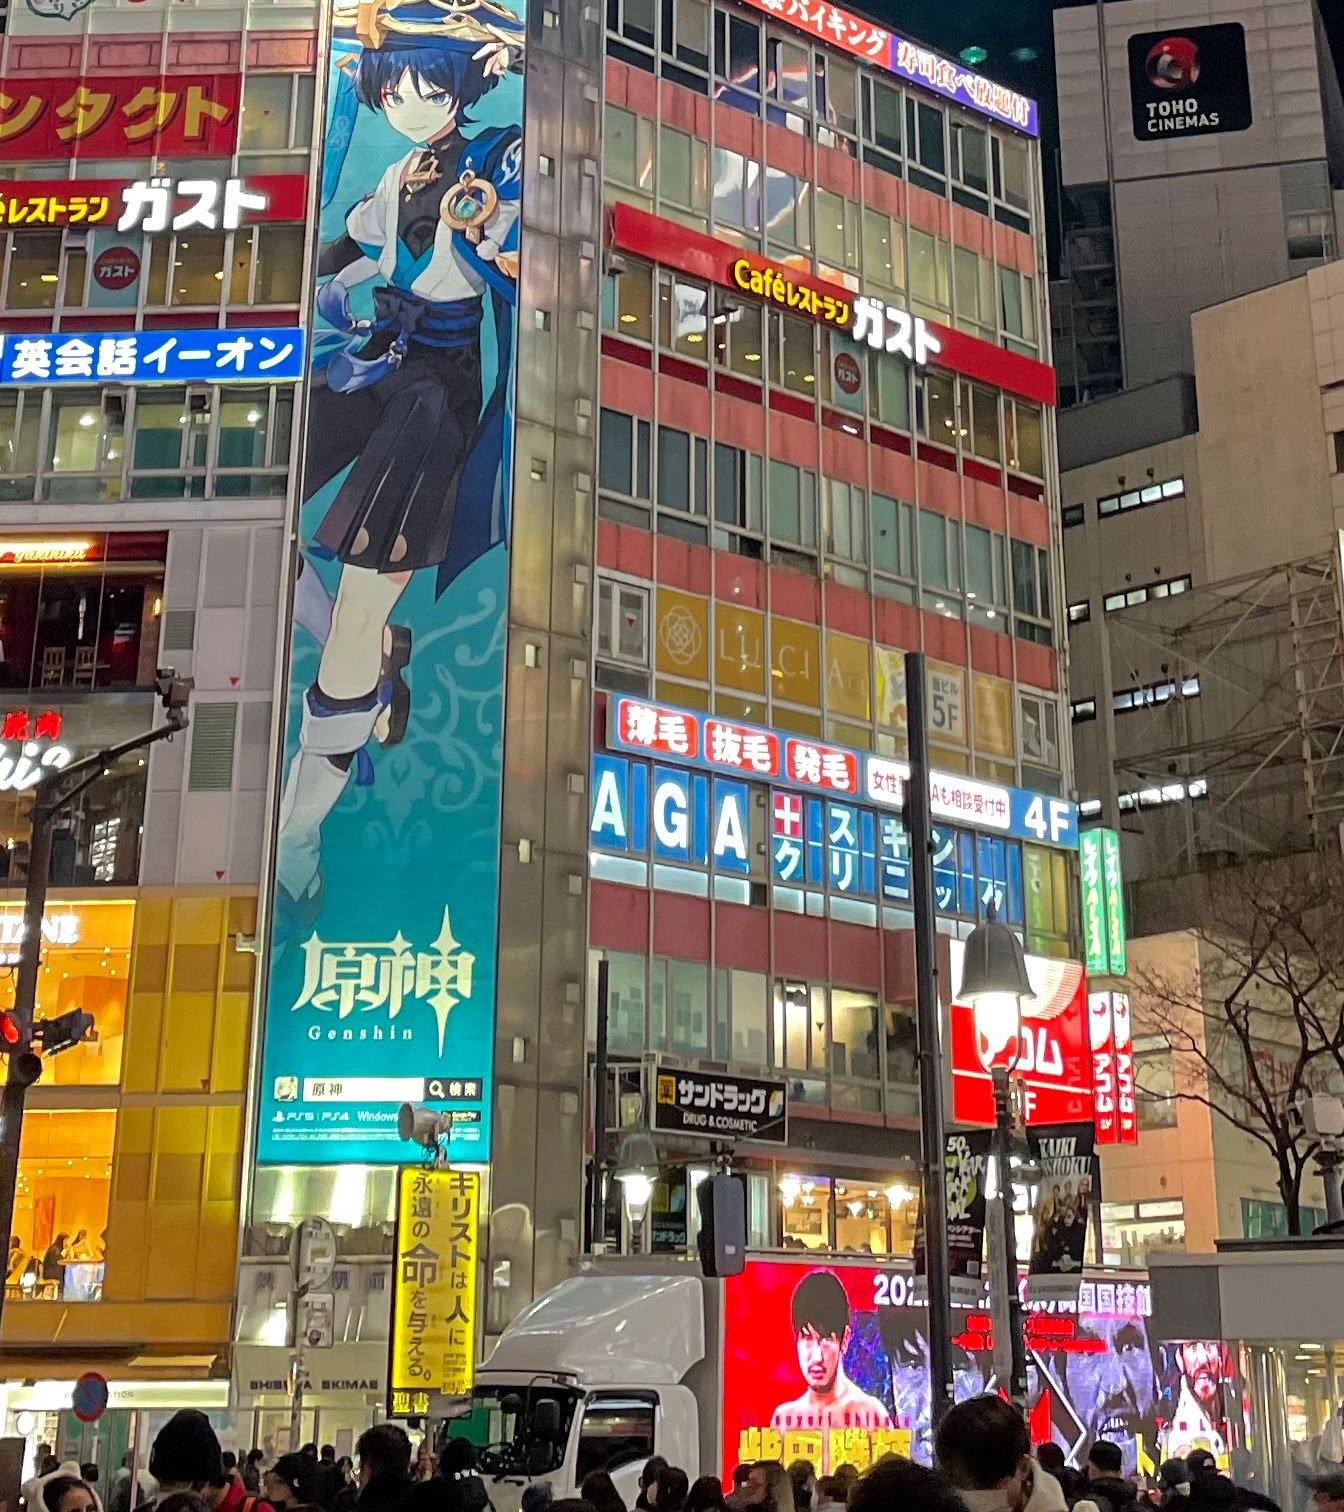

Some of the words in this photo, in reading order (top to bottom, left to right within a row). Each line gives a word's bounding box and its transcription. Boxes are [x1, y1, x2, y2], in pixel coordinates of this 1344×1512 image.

[1146, 99, 1198, 117] TOHO
[1147, 112, 1220, 132] CINEMAS
[117, 179, 268, 232] ガスト
[98, 258, 137, 281] ガスト
[734, 259, 849, 325] Caféレストラン
[853, 296, 942, 366] ガスト
[12, 336, 294, 378] 英会話イーオン
[626, 705, 688, 755] 薄毛
[932, 696, 959, 731] 5F
[712, 727, 773, 773] 抜毛
[792, 747, 851, 790] 発毛
[590, 772, 748, 859] AGA
[1024, 797, 1070, 842] 4F
[291, 904, 477, 1059] 原神
[308, 1025, 413, 1041] Genshin
[311, 1082, 343, 1097] 原神
[678, 1080, 766, 1115] サンドラッグ
[1094, 1054, 1113, 1113] アコム
[321, 1112, 351, 1121] PS4
[357, 1110, 399, 1122] Windows
[682, 1111, 707, 1127] DRUG
[716, 1116, 758, 1133] COSMETIC
[445, 1172, 475, 1347] キリストは人に
